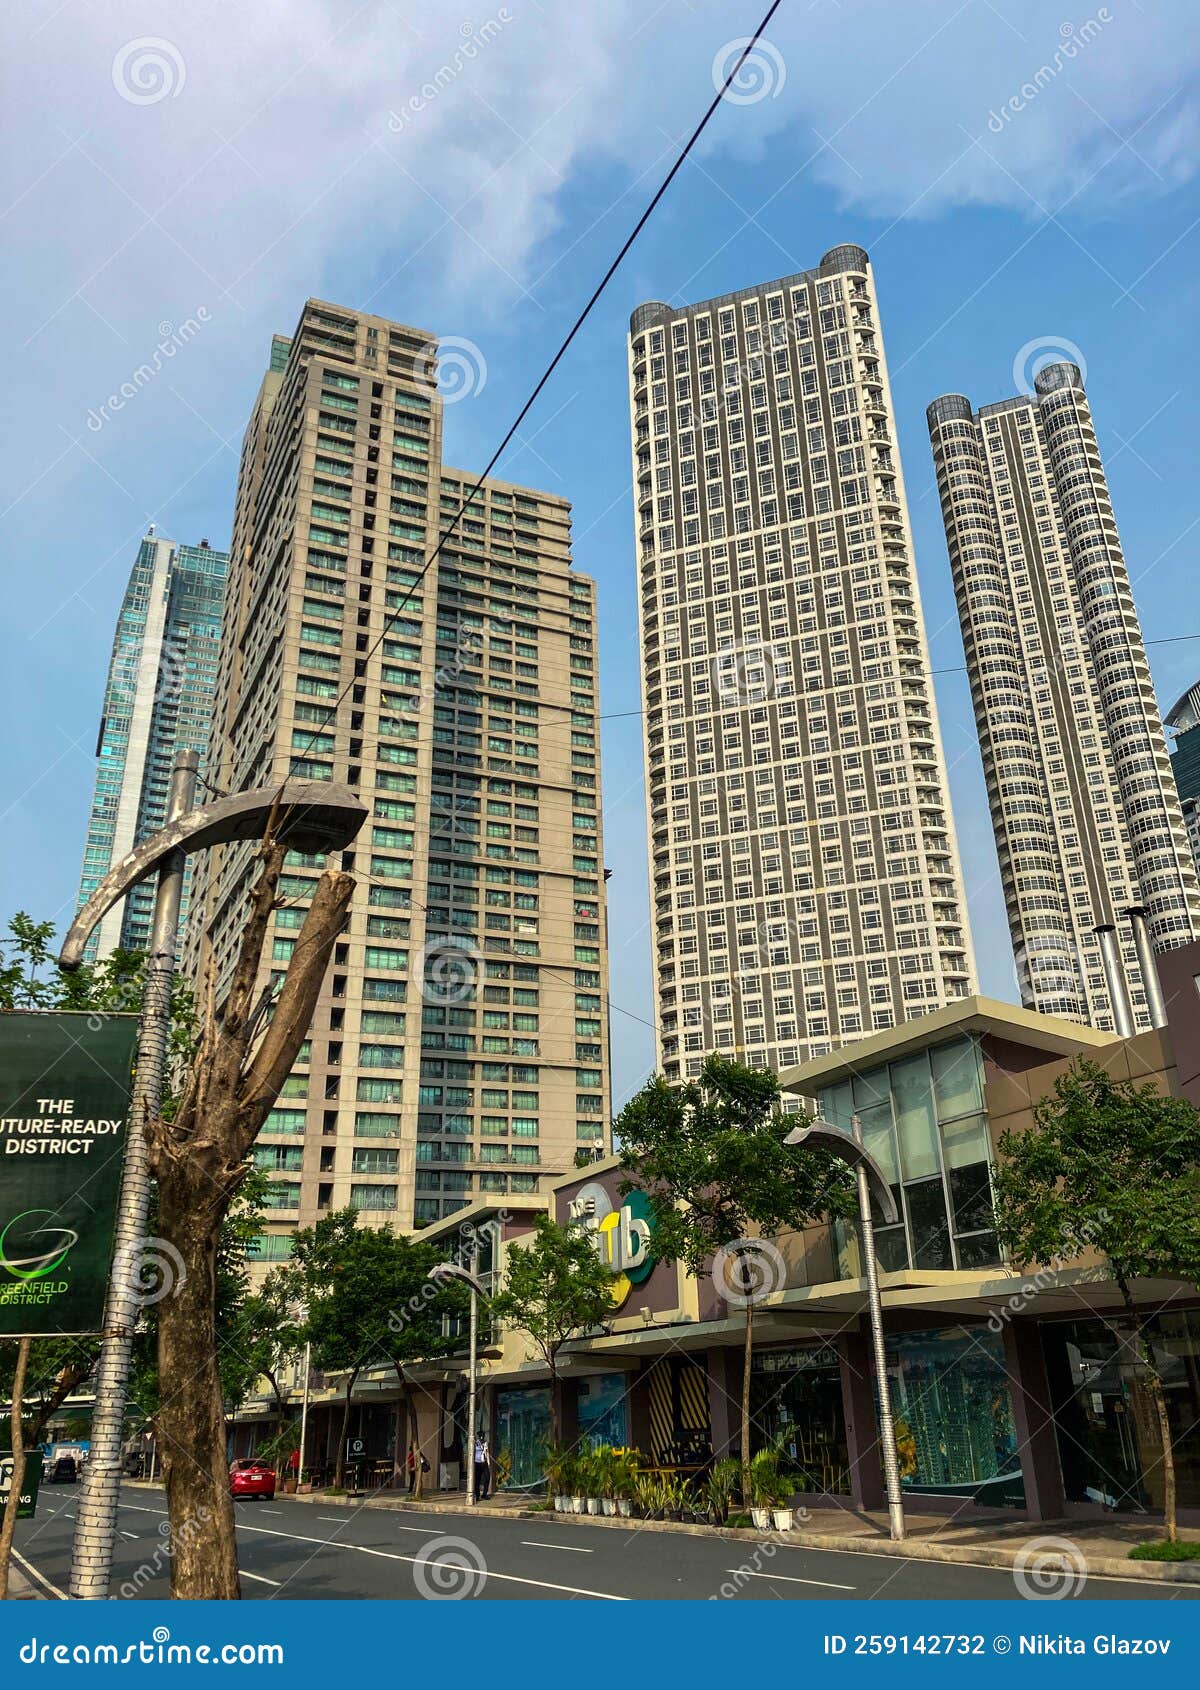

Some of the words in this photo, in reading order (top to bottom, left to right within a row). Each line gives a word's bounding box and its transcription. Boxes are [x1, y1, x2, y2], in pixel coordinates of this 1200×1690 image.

[36, 1099, 75, 1114] THE
[0, 1118, 122, 1135] TURE-READY
[5, 1138, 95, 1154] DISTRICT
[0, 1281, 69, 1295] REENFIELD
[0, 1294, 53, 1305] DISTRICT
